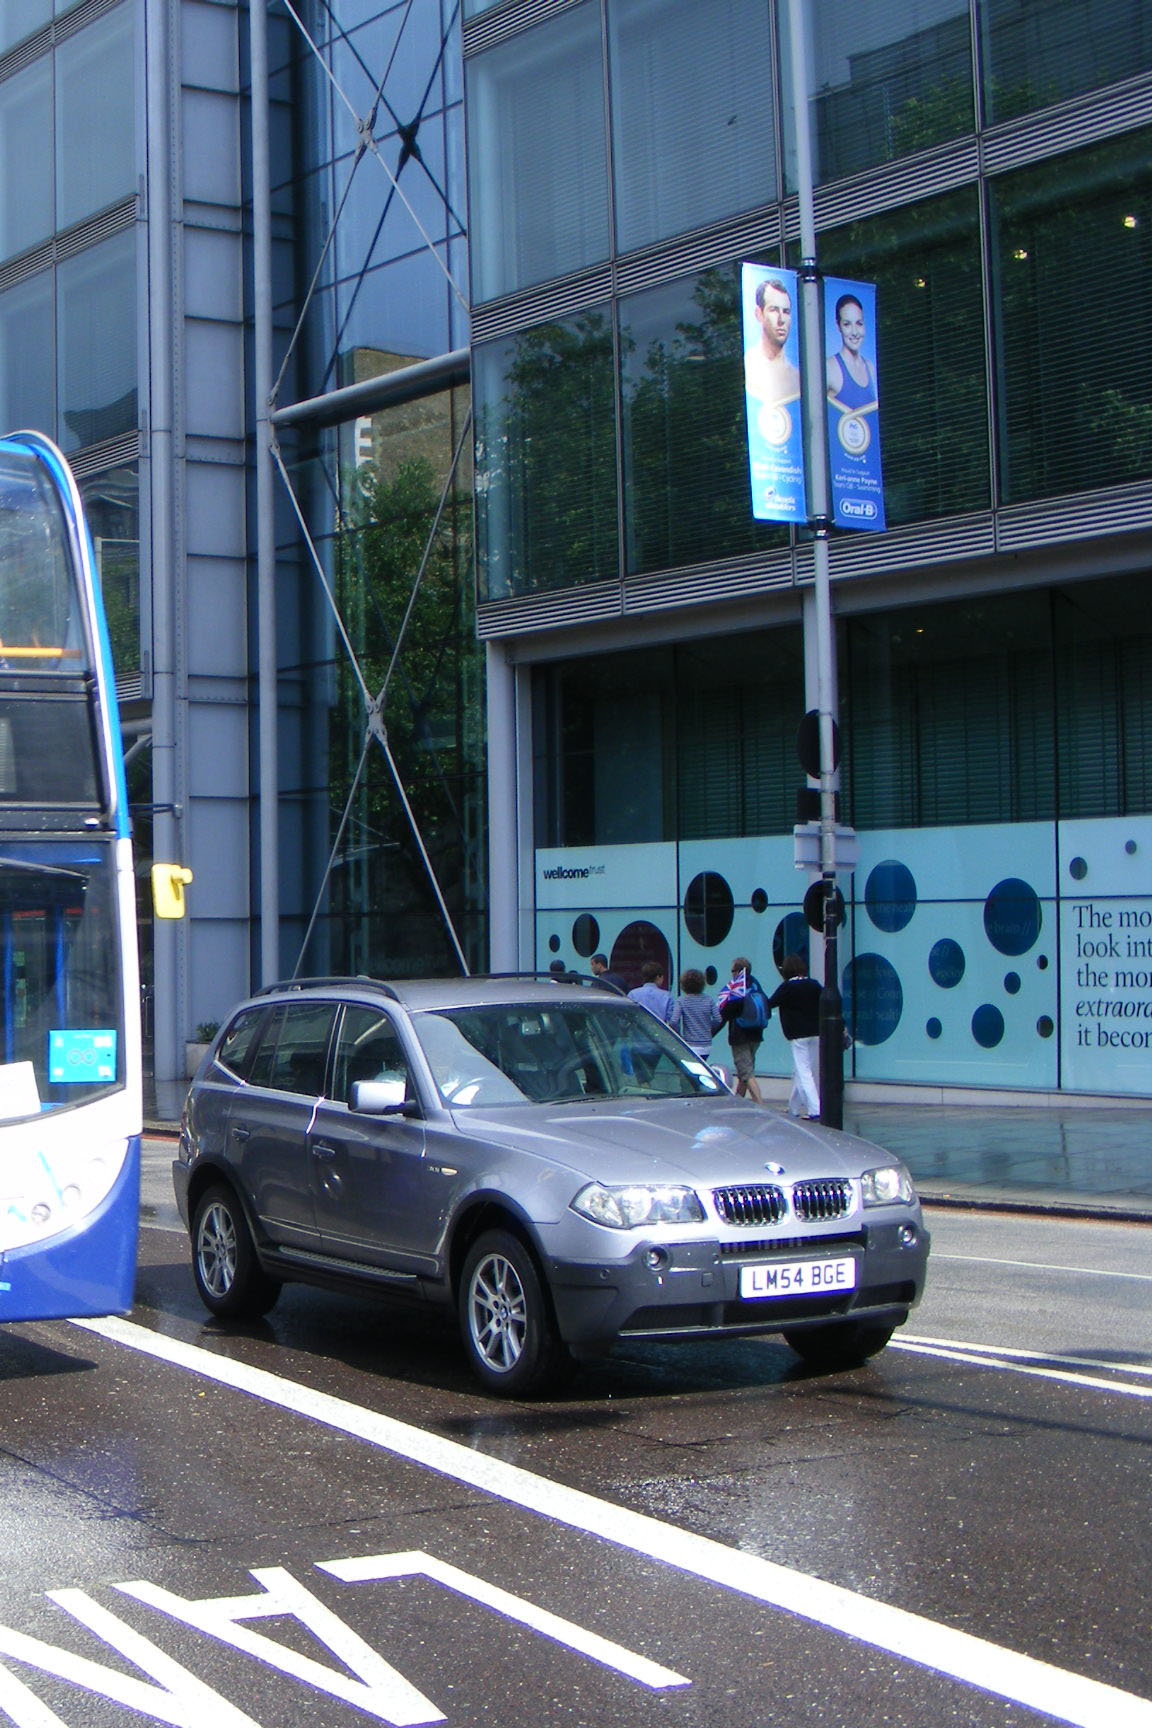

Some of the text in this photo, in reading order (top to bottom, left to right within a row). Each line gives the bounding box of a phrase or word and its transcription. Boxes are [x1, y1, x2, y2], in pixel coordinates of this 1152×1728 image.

[842, 501, 874, 516] Oral-B
[1072, 903, 1112, 929] The
[1076, 933, 1120, 958] look
[1076, 963, 1108, 988] the
[1078, 1023, 1092, 1047] it
[752, 1263, 846, 1291] LM54 BGE
